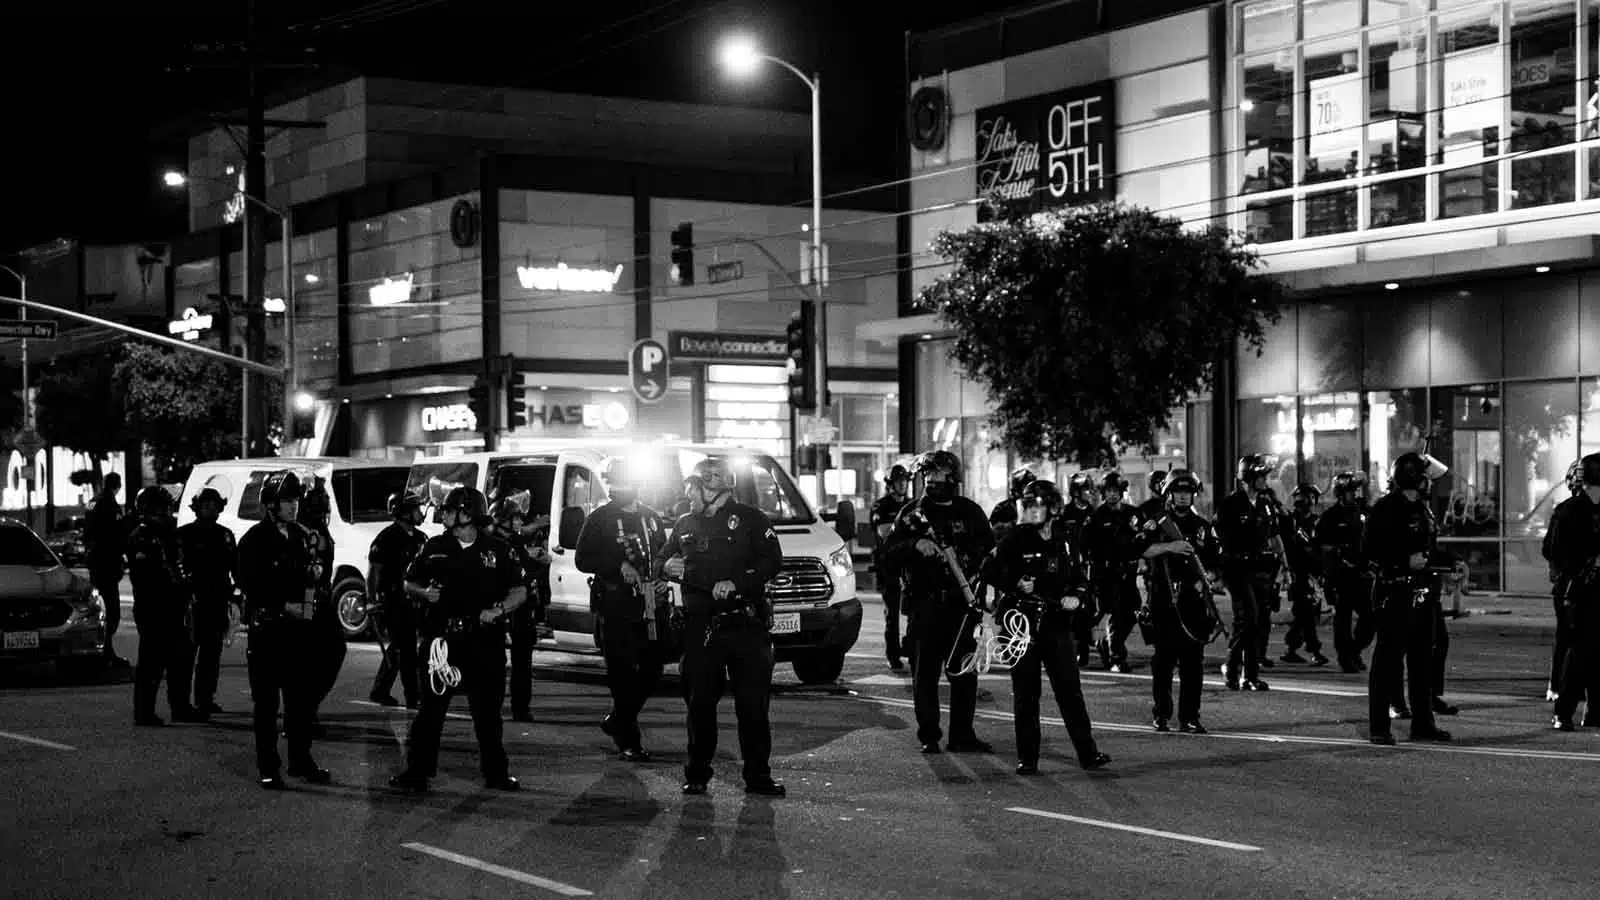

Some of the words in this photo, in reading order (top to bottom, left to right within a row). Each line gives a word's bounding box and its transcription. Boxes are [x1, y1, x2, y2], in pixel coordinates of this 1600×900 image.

[976, 116, 1017, 161] Saks
[1048, 96, 1102, 150] OFF
[1048, 143, 1103, 197] 5TH
[641, 346, 662, 372] P
[527, 403, 600, 427] HASE
